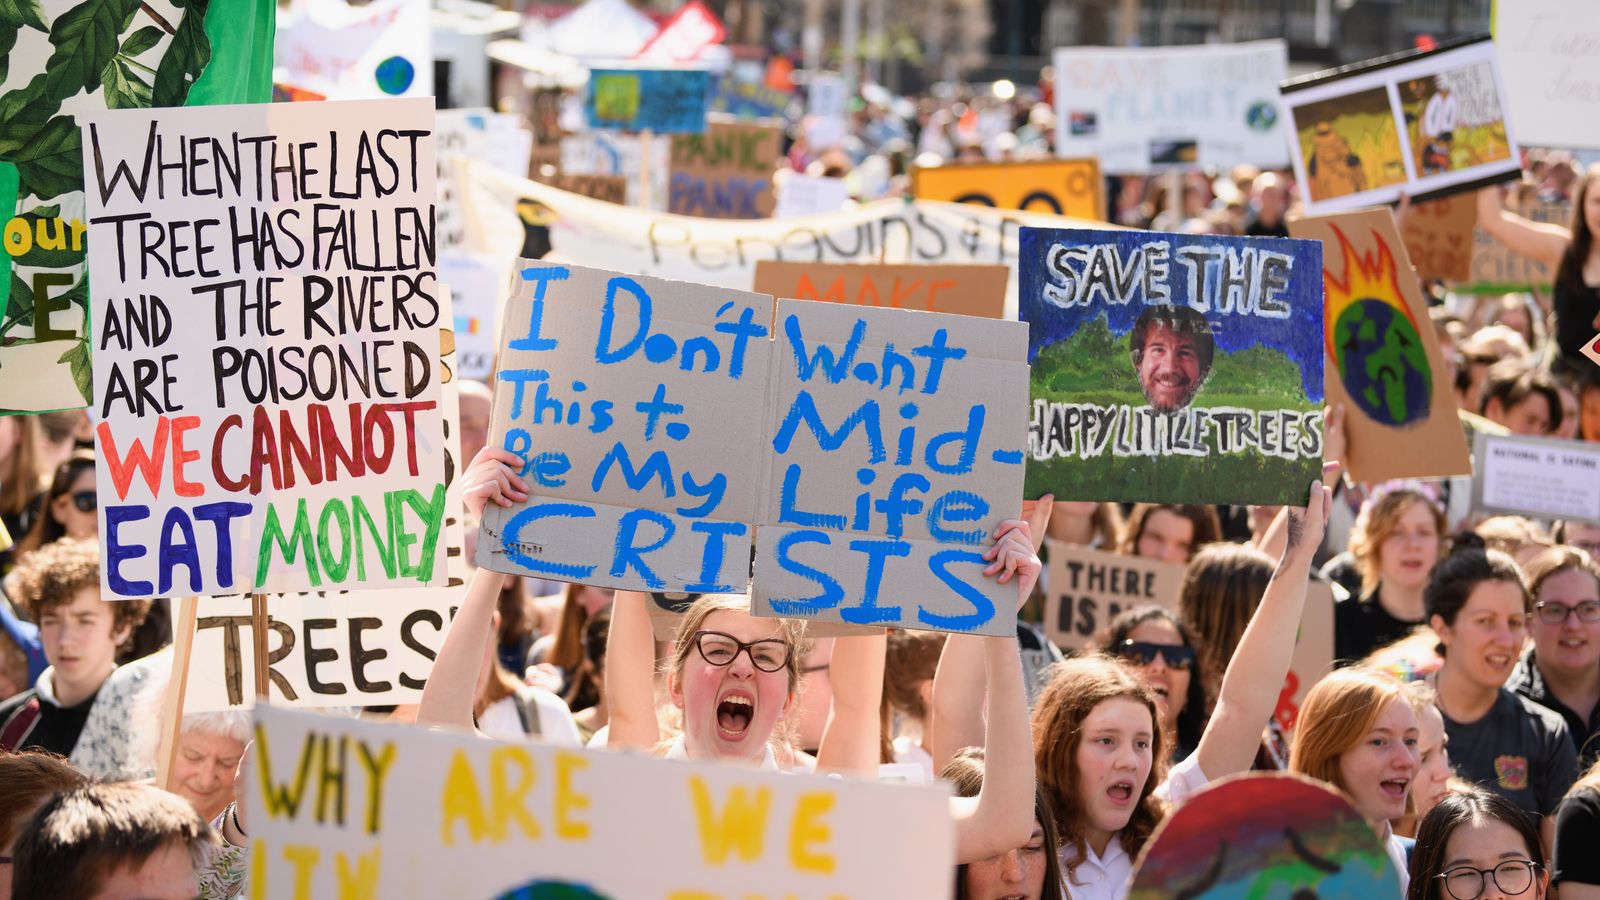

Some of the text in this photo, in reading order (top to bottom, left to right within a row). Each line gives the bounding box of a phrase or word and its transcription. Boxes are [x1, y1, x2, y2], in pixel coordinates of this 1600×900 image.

[89, 120, 242, 207] WHEN
[239, 135, 322, 202] THE
[329, 128, 431, 200] LAST
[669, 171, 769, 219] PANIC
[89, 203, 436, 283] TREE HAS FALLEN
[1043, 240, 1295, 319] SAVE THE
[101, 271, 440, 351] AND THE RIVERS
[508, 265, 967, 396] I Don't Want
[102, 340, 431, 419] ARE POISONED
[496, 368, 614, 434] This
[635, 383, 691, 442] to
[96, 400, 437, 502] WE CANNOT
[1028, 398, 1324, 460] HAPPY LITTLE TREES
[503, 427, 990, 546] Be My Life
[105, 501, 254, 596] EAT
[255, 482, 446, 588] MONEY
[1057, 595, 1098, 637] IS
[1065, 560, 1157, 599] THERE
[254, 721, 838, 876] WHY ARE WE
